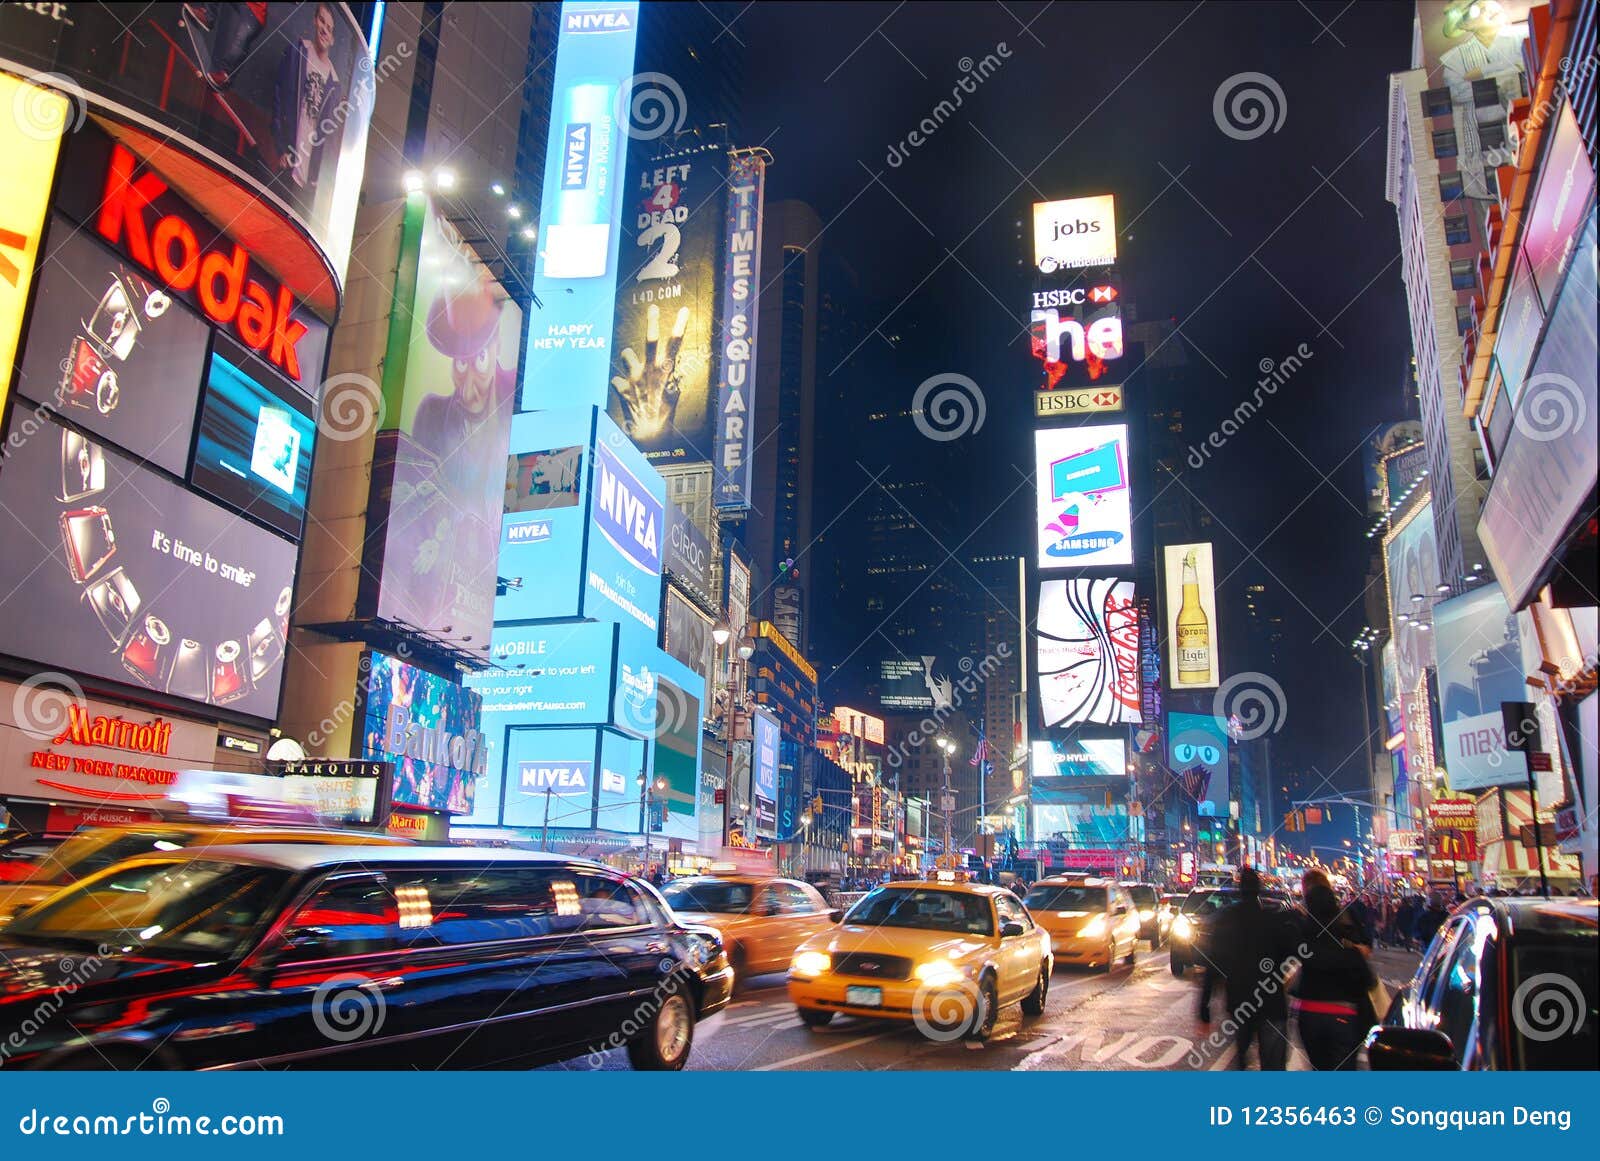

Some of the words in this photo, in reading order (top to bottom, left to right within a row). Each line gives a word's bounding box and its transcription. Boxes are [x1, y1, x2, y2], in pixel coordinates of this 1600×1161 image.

[568, 12, 631, 28] NIVEA
[566, 127, 587, 185] NIVEA
[641, 164, 691, 189] LEFT
[651, 185, 674, 209] 4
[637, 206, 689, 230] DEAD
[1053, 219, 1101, 241] jobs
[636, 222, 682, 282] 2
[729, 185, 755, 300] TIMES
[96, 142, 308, 381] Kodak
[1059, 256, 1115, 269] Prudential
[1032, 289, 1086, 308] HSBC
[548, 324, 593, 337] HAPPY
[534, 338, 569, 350] NEW
[572, 337, 605, 349] YEAR
[723, 314, 751, 467] SQUARE
[1039, 394, 1090, 410] HSBC
[722, 484, 740, 493] NYC
[600, 465, 658, 559] NIVEA
[508, 524, 549, 538] NIVEA
[1055, 537, 1115, 550] SAMSUNG
[173, 539, 202, 566] time
[205, 553, 219, 573] to
[493, 640, 546, 656] MOBILE
[548, 667, 557, 675] to
[559, 666, 577, 678] your
[580, 664, 595, 674] left
[493, 687, 510, 697] your
[513, 685, 533, 697] right
[54, 703, 172, 755] Marriott
[384, 703, 453, 767] Bank
[32, 751, 71, 772] NEW
[74, 756, 114, 778] YORK
[285, 763, 380, 775] MARQUIS
[522, 768, 586, 787] NIVEA
